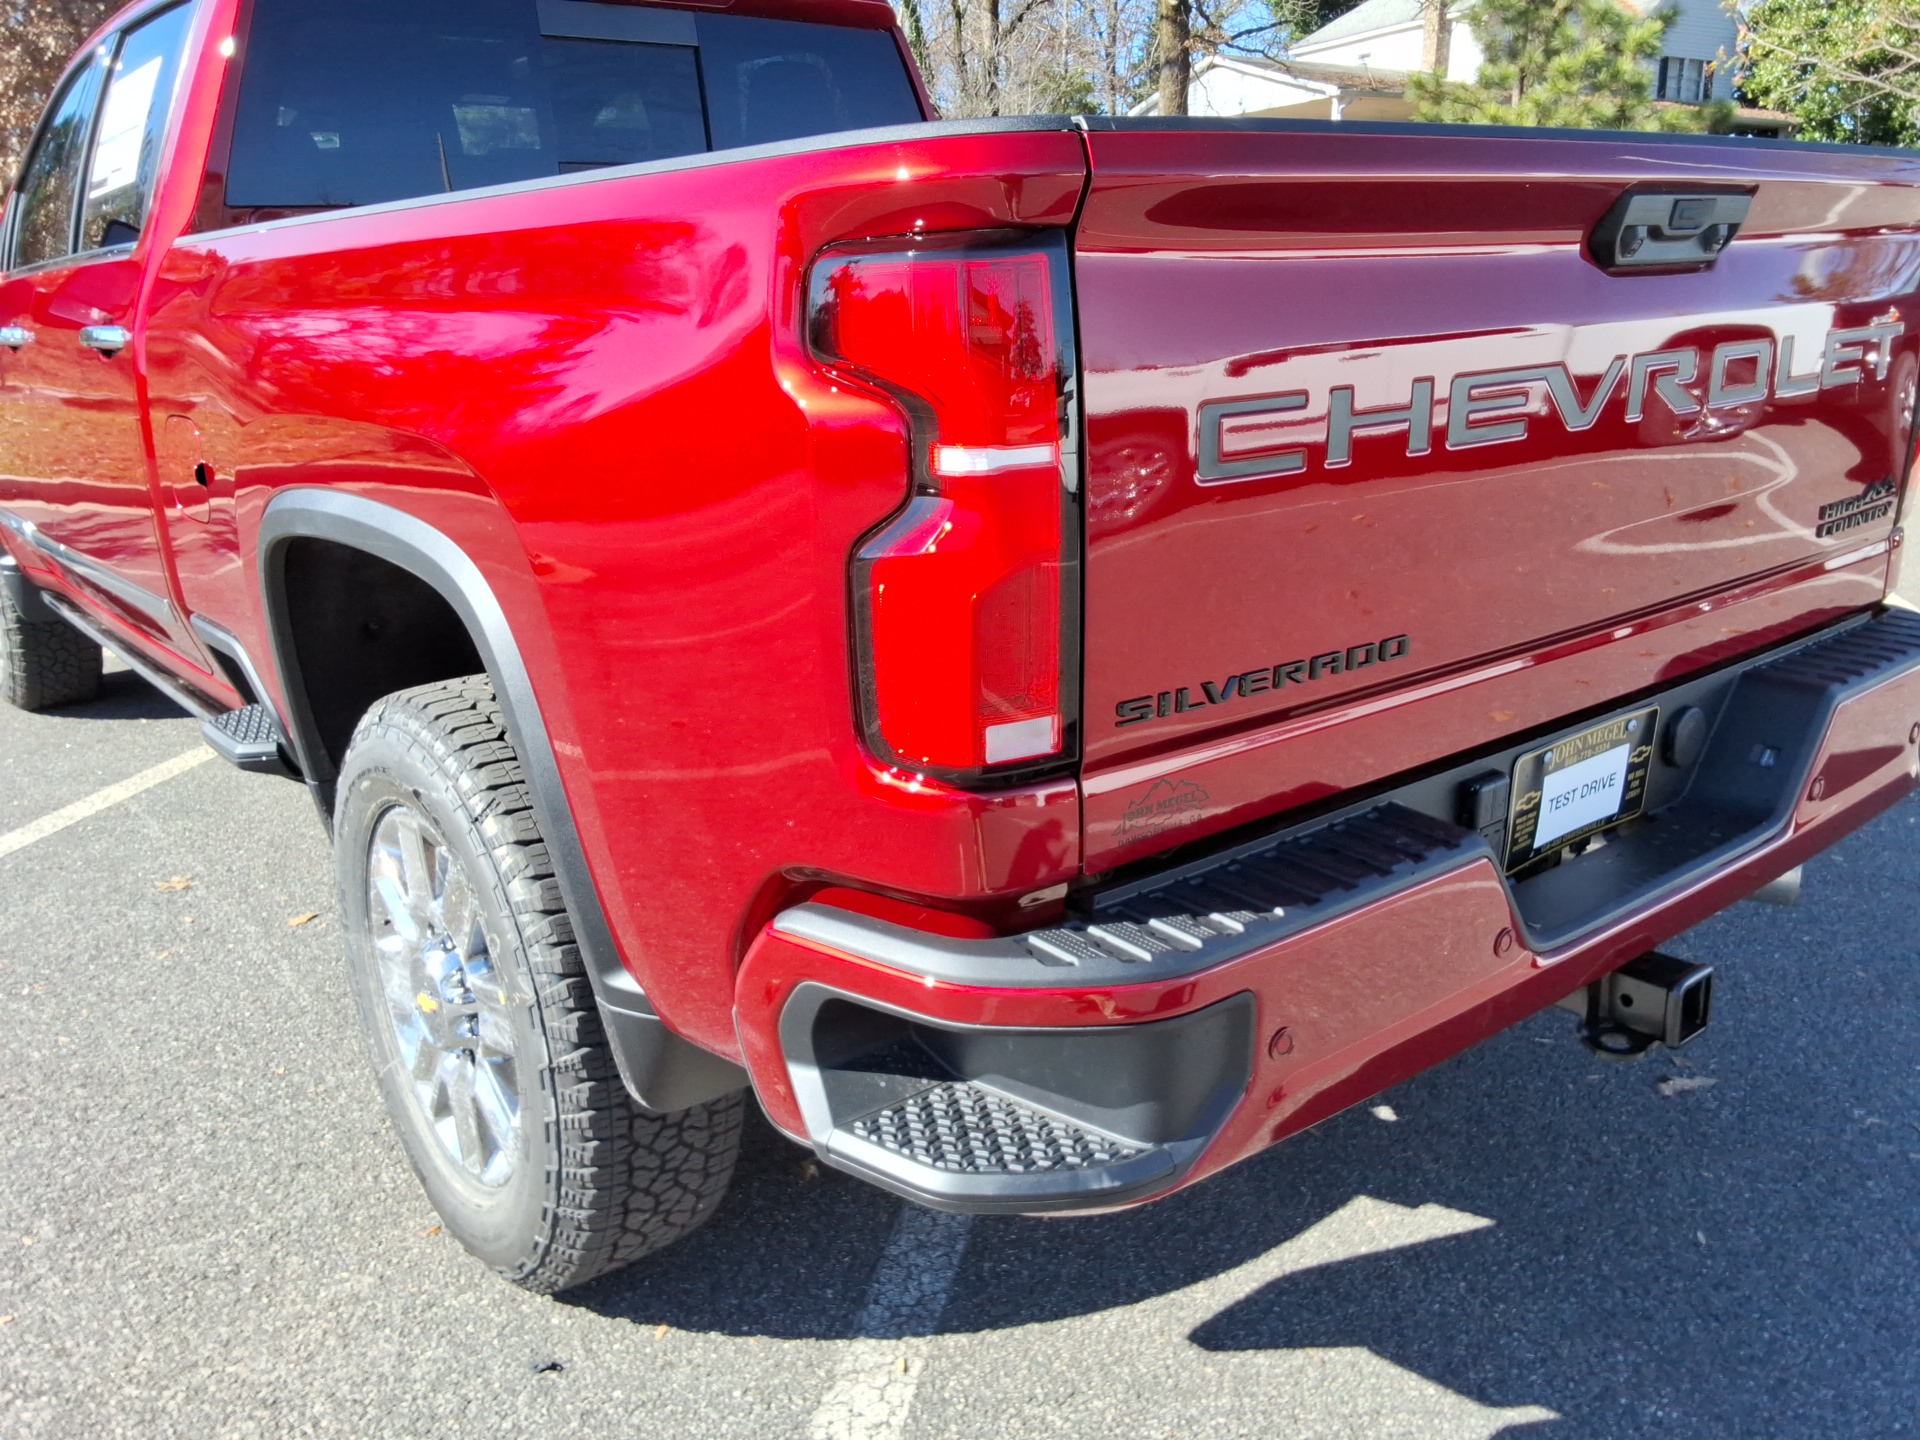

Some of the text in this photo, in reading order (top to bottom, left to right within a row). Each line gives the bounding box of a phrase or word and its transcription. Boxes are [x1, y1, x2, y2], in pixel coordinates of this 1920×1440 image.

[1194, 321, 1905, 486] CHEVROLET
[1815, 501, 1893, 538] COUNTRY
[1818, 495, 1864, 520] HIGH
[1115, 634, 1411, 728] SILVERADO
[1548, 721, 1627, 771] JOHN MEGEL
[1549, 772, 1617, 813] TEST DRIVE
[1122, 803, 1154, 835] JOHN
